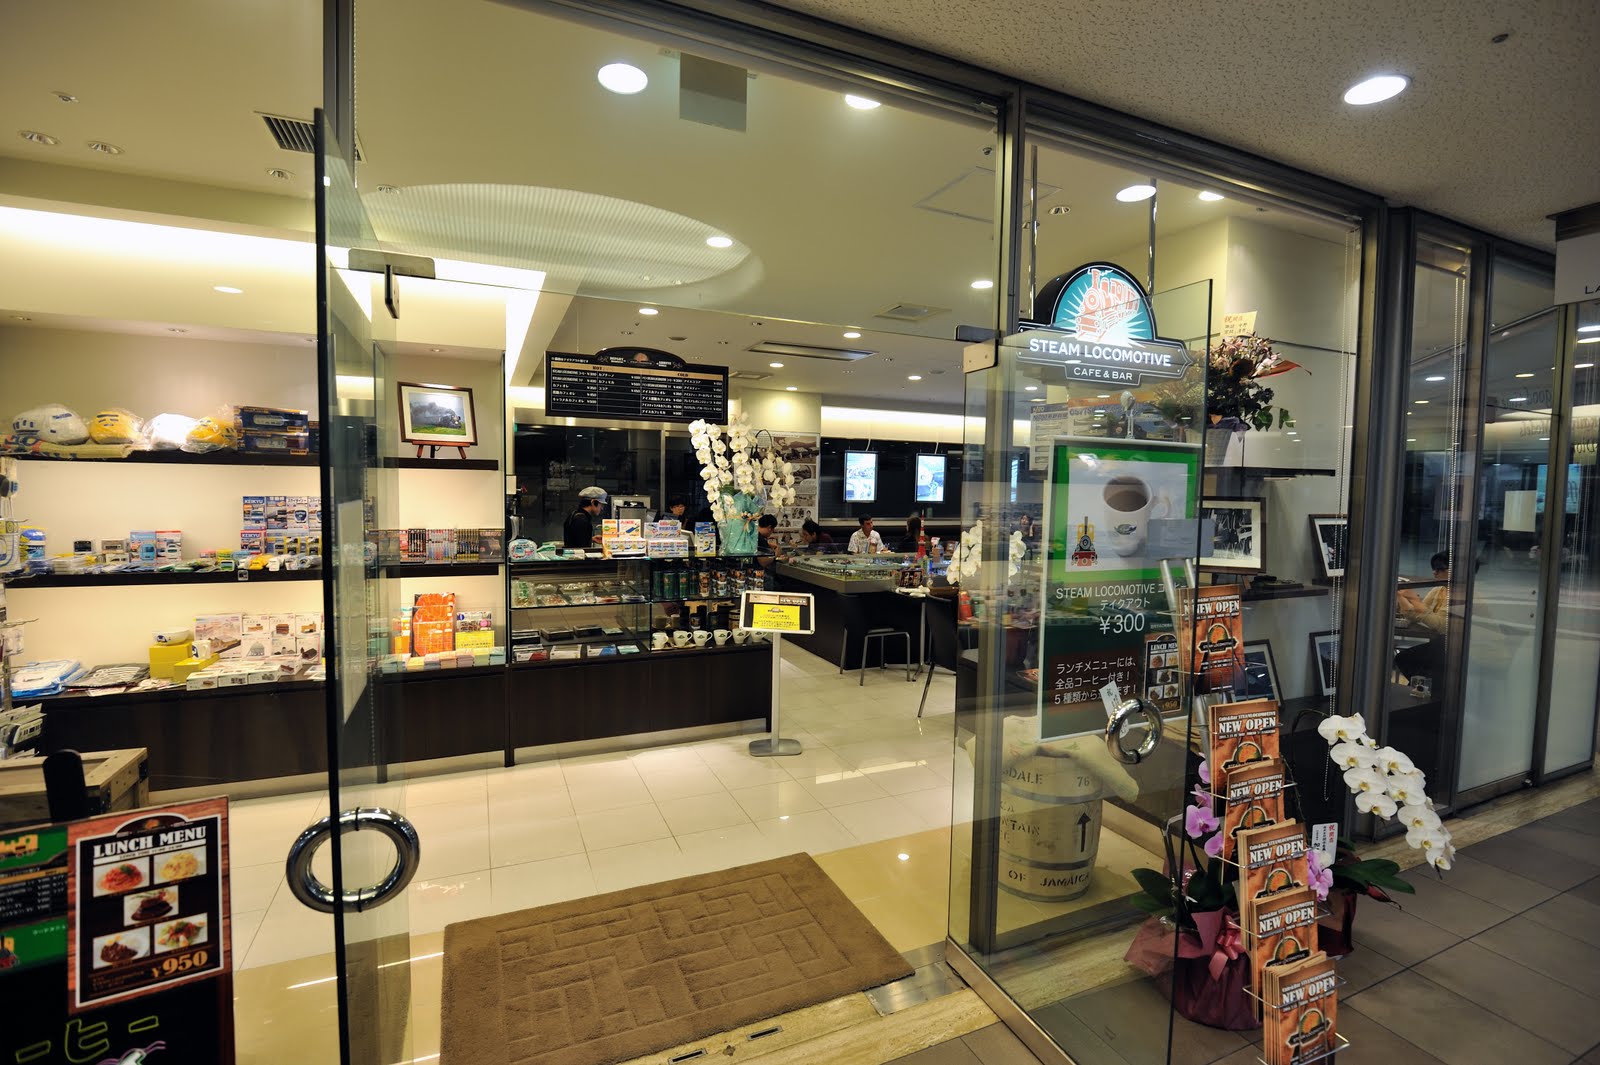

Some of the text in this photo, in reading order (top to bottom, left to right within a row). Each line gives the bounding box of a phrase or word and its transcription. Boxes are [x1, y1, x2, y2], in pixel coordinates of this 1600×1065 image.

[1029, 338, 1172, 367] STEAM LOCOMOTIVE
[1073, 367, 1102, 378] CAFE
[1112, 371, 1133, 380] BAR
[1056, 587, 1092, 599] STEAM
[1095, 583, 1156, 597] LOCOMOTIVE
[1215, 600, 1240, 613] OPEN
[1100, 612, 1145, 635] ¥300
[1150, 643, 1167, 651] LUNCH
[1219, 717, 1276, 734] NEW OPEN
[1230, 780, 1283, 799] NEW OPEN
[93, 826, 207, 858] LUNCH MENU
[1250, 847, 1273, 864] NEW
[1275, 840, 1304, 857] OPEN
[1008, 869, 1026, 882] OF
[1259, 906, 1315, 933] NEW OPEN
[1282, 987, 1305, 1005] NEW
[1308, 976, 1336, 997] OPEN
